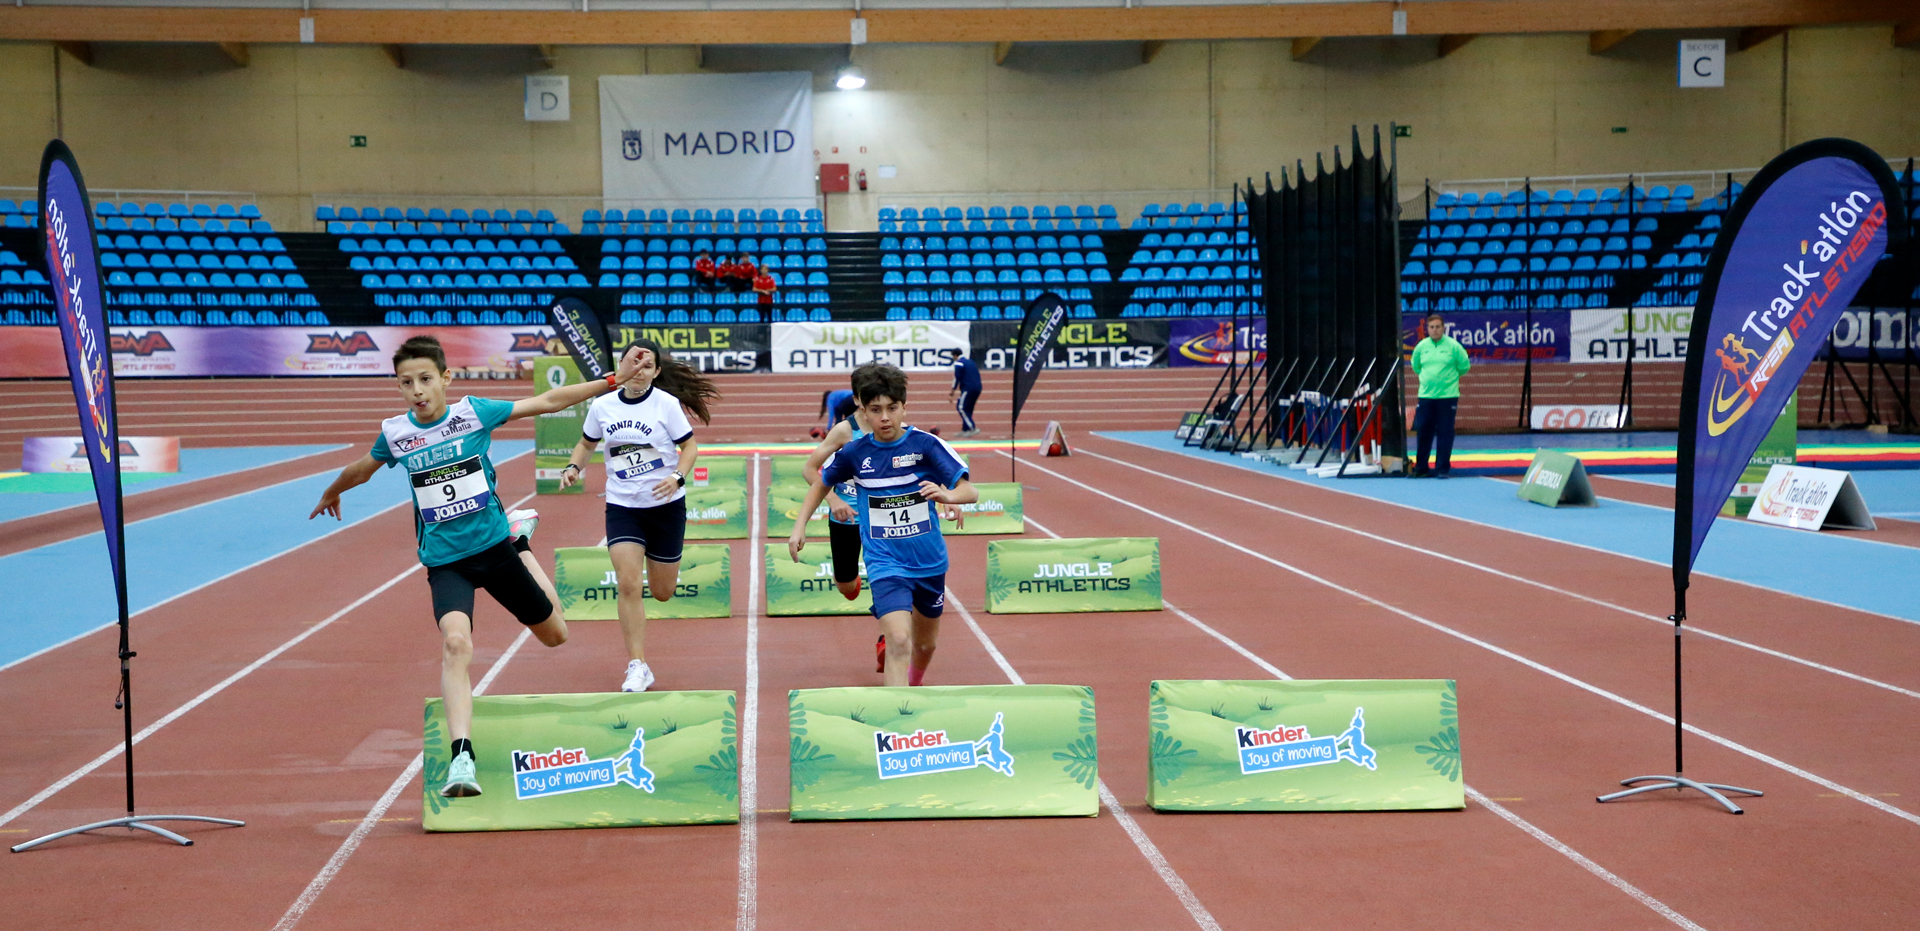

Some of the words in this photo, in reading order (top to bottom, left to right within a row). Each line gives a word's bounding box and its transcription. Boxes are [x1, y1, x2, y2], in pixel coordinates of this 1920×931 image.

[1694, 56, 1712, 77] C
[541, 92, 558, 110] D
[664, 130, 795, 156] MADRID
[1788, 201, 1888, 340] ATLETISMO
[1024, 308, 1053, 357] JUNGLE
[1614, 312, 1691, 334] JUNG
[305, 331, 380, 356] DNA
[814, 325, 930, 345] JUNGLE
[1023, 305, 1064, 373] ATHLETICS
[788, 348, 956, 368] ATHLETICS
[985, 346, 1154, 369] ATLETICS
[1588, 338, 1690, 359] ATHLE
[552, 369, 561, 385] 4
[606, 420, 633, 436] SANTA
[634, 421, 653, 436] ANA
[626, 452, 644, 467] 12
[1749, 456, 1793, 464] THLETICS
[425, 469, 468, 485] ATHLETICS
[429, 465, 460, 478] JUNGLE
[442, 484, 457, 502] 9
[880, 499, 916, 508] ATHLETICS
[889, 509, 911, 525] 14
[1033, 562, 1113, 578] JUNGLE
[584, 584, 699, 601] ATHECS
[1018, 577, 1131, 593] ATHLETICS
[884, 757, 907, 771] Joy
[910, 753, 923, 767] of
[926, 750, 970, 765] moving
[1246, 752, 1270, 766] Joy
[1272, 748, 1284, 762] of
[1287, 744, 1332, 759] moving
[522, 777, 546, 791] Joy
[548, 771, 562, 786] of
[565, 767, 610, 784] moving
